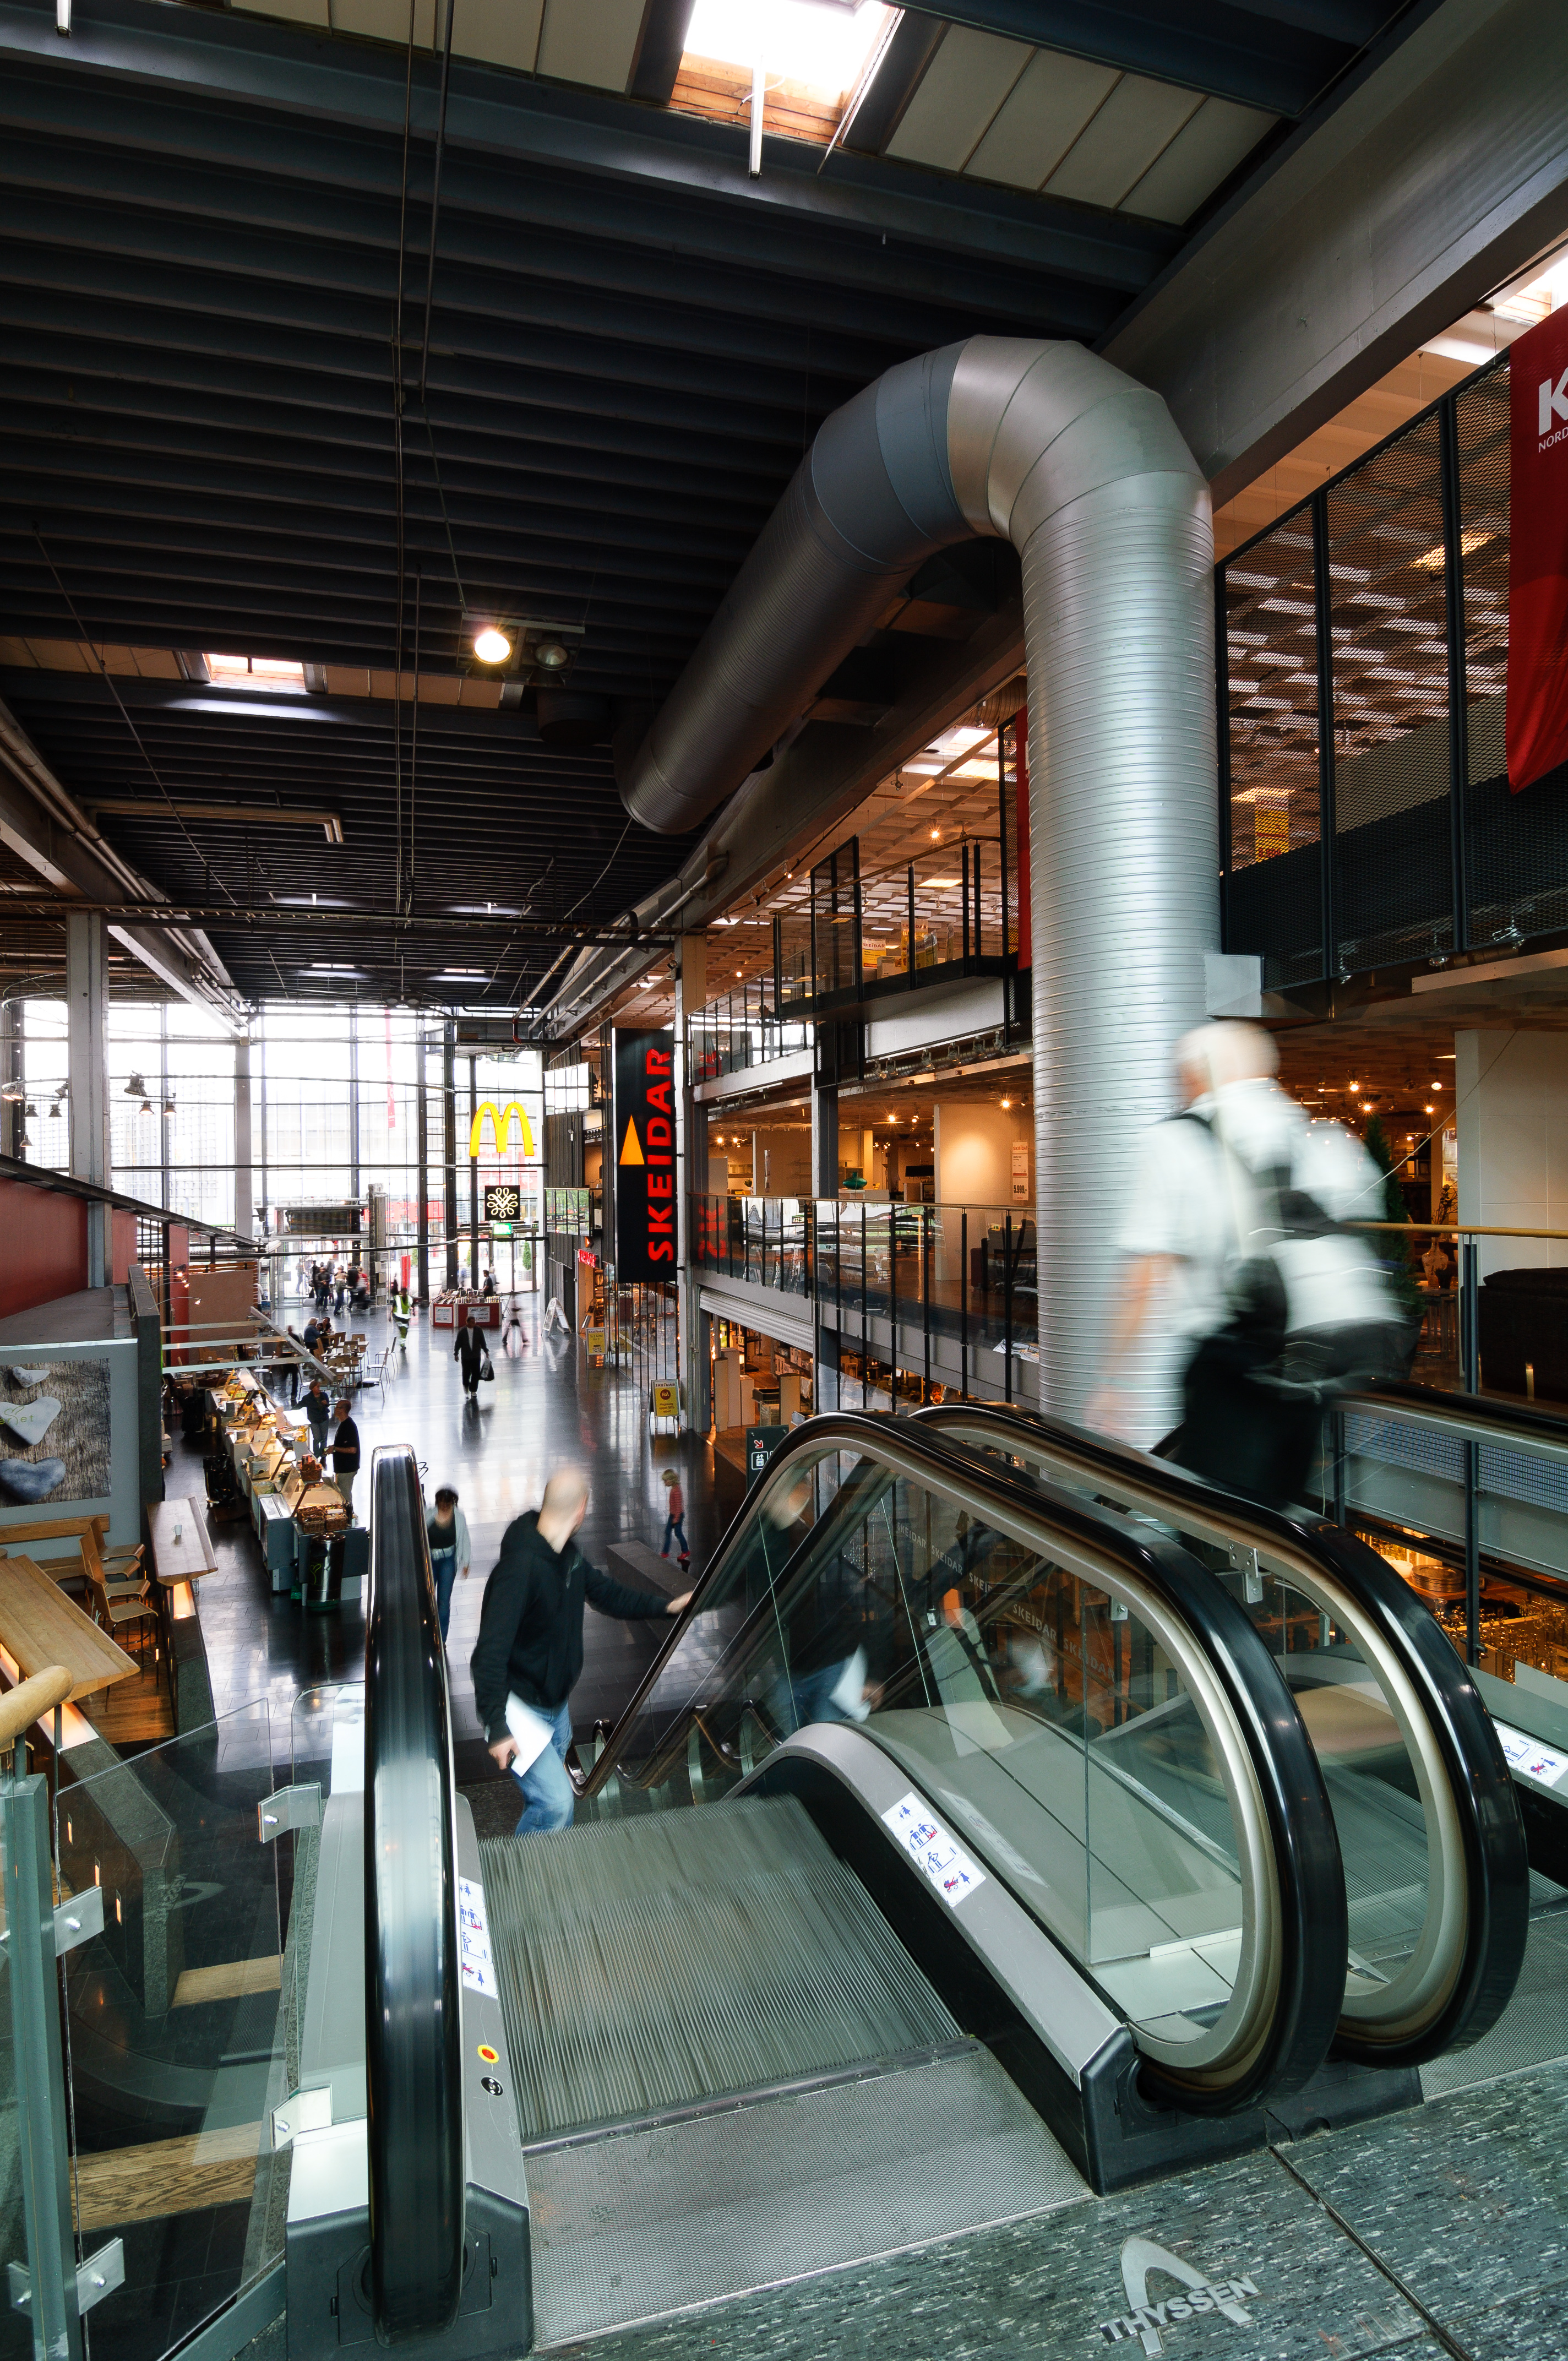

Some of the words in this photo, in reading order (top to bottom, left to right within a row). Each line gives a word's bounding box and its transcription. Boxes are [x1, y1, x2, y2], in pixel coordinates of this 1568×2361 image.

[646, 1048, 674, 1261] SKEIDAR
[897, 1522, 927, 1549] SKEIDAR
[932, 1545, 963, 1575] SKEIDAR
[1013, 1603, 1057, 1641] SKEIDAR
[1099, 2275, 1262, 2340] THYSSEN
